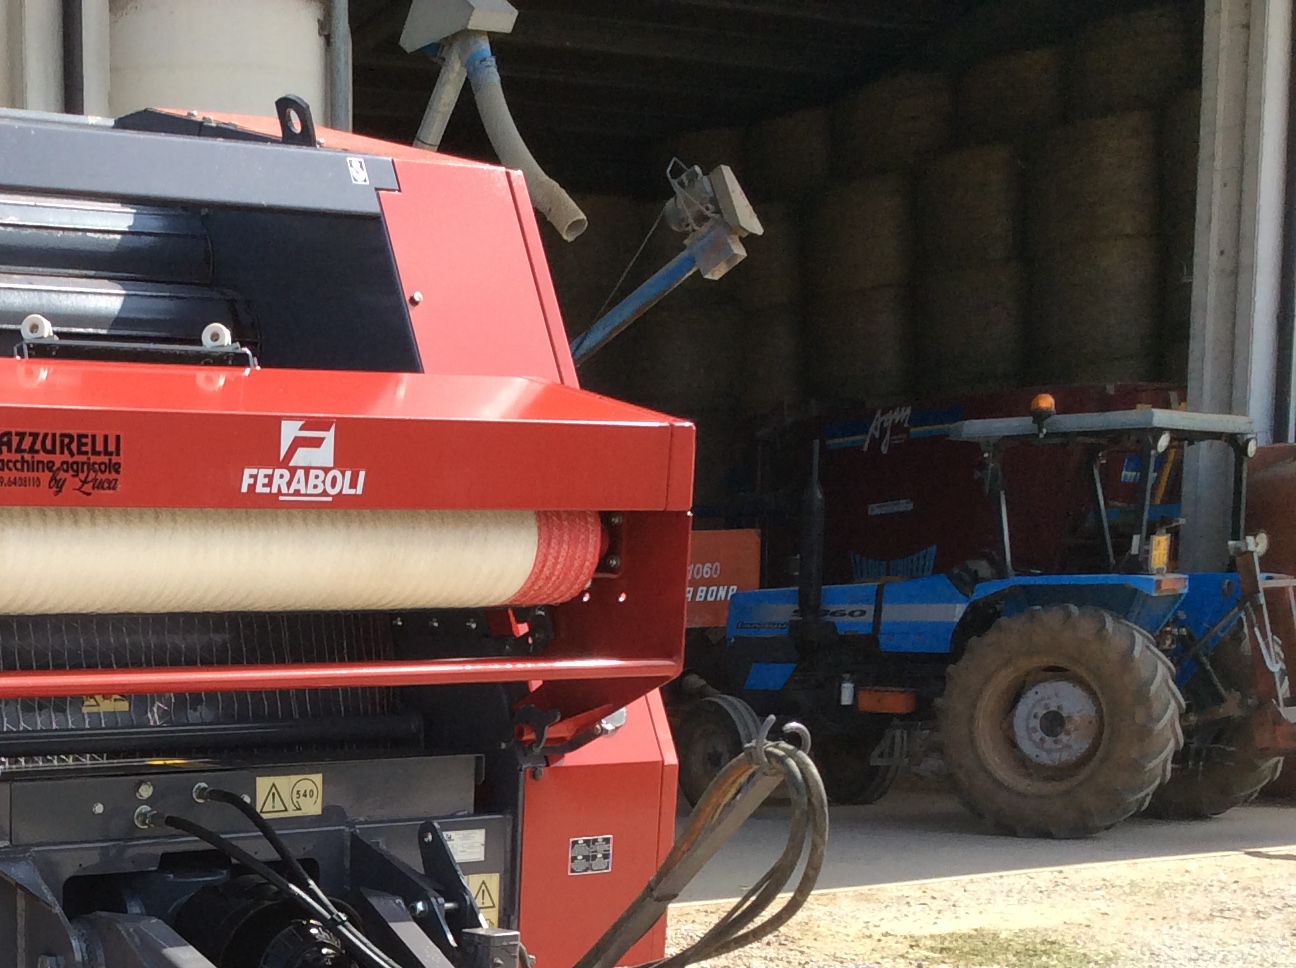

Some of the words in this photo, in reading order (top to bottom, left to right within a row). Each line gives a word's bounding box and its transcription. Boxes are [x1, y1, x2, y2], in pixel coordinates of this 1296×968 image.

[60, 457, 121, 478] agricole
[48, 466, 67, 496] by
[72, 467, 120, 497] Luca
[240, 468, 366, 495] FERABOLI
[295, 789, 315, 799] 540
